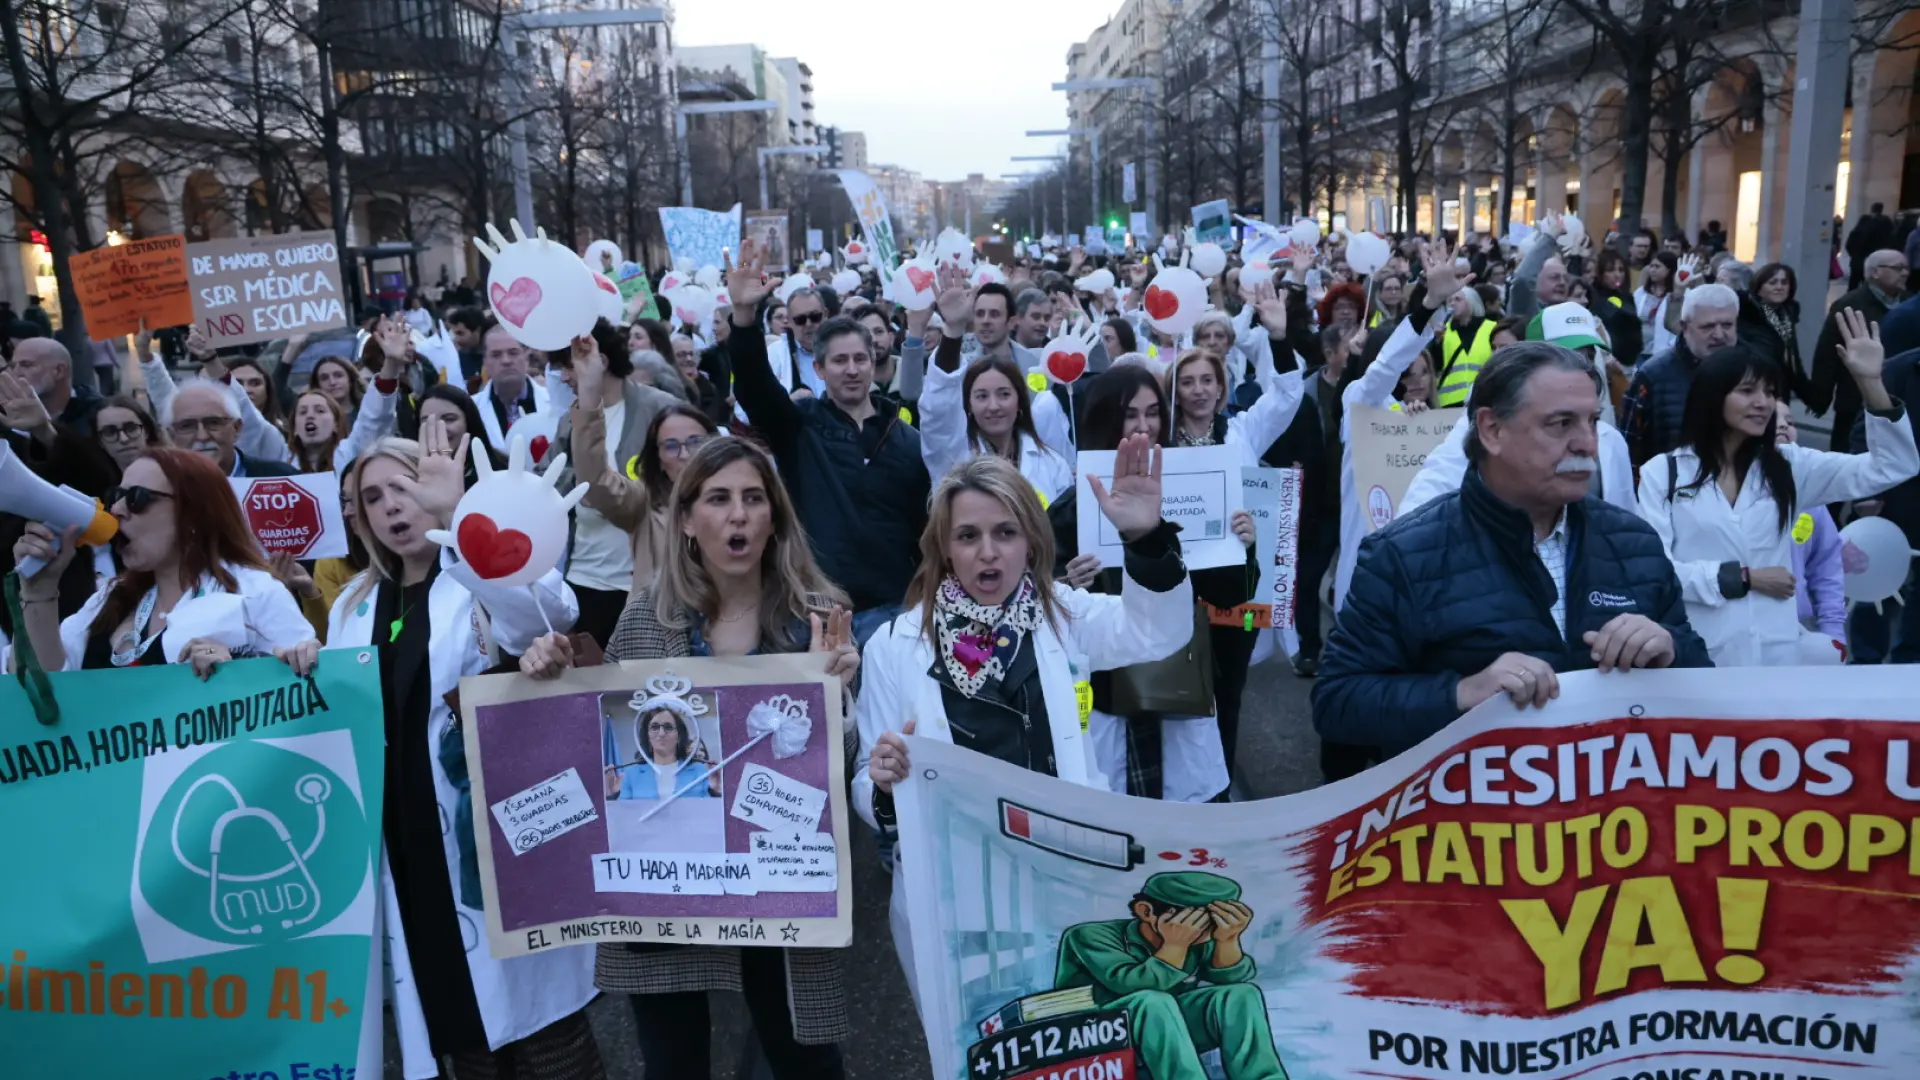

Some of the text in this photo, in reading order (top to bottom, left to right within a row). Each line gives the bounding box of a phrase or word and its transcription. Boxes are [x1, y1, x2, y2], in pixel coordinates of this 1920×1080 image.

[192, 255, 214, 276] DE
[219, 252, 270, 271] MAYOR
[275, 243, 337, 267] QUIERO
[201, 285, 238, 308] SER
[243, 269, 335, 302] MÉDICA
[206, 298, 346, 338] NO ESCLAVA
[1370, 422, 1408, 436] TRABAJAR
[1416, 424, 1428, 436] AL
[1386, 454, 1427, 468] RIESGO
[252, 492, 300, 510] STOP
[258, 526, 310, 539] GUARDIAS
[273, 537, 307, 548] HORAS
[1274, 573, 1288, 594] NO
[1215, 607, 1233, 617] DO
[175, 677, 329, 749] COMPUTADA
[511, 786, 556, 811] SEMANA
[775, 788, 804, 806] HORAS
[1329, 732, 1854, 870] ¡NECESITAMOS
[776, 844, 797, 852] HORAS
[1325, 806, 1648, 904] ESTATUTO
[600, 858, 630, 880] TU
[640, 859, 679, 880] HADA
[527, 930, 551, 950] EL
[560, 920, 643, 941] MINISTERIO
[658, 922, 676, 938] DE
[685, 922, 702, 938] LA
[1498, 876, 1768, 1011] YA!
[0, 948, 349, 1023] imiento A1+
[1068, 1016, 1127, 1051] AÑOS
[1368, 1010, 1877, 1074] POR NUESTRA FORMACIÓN
